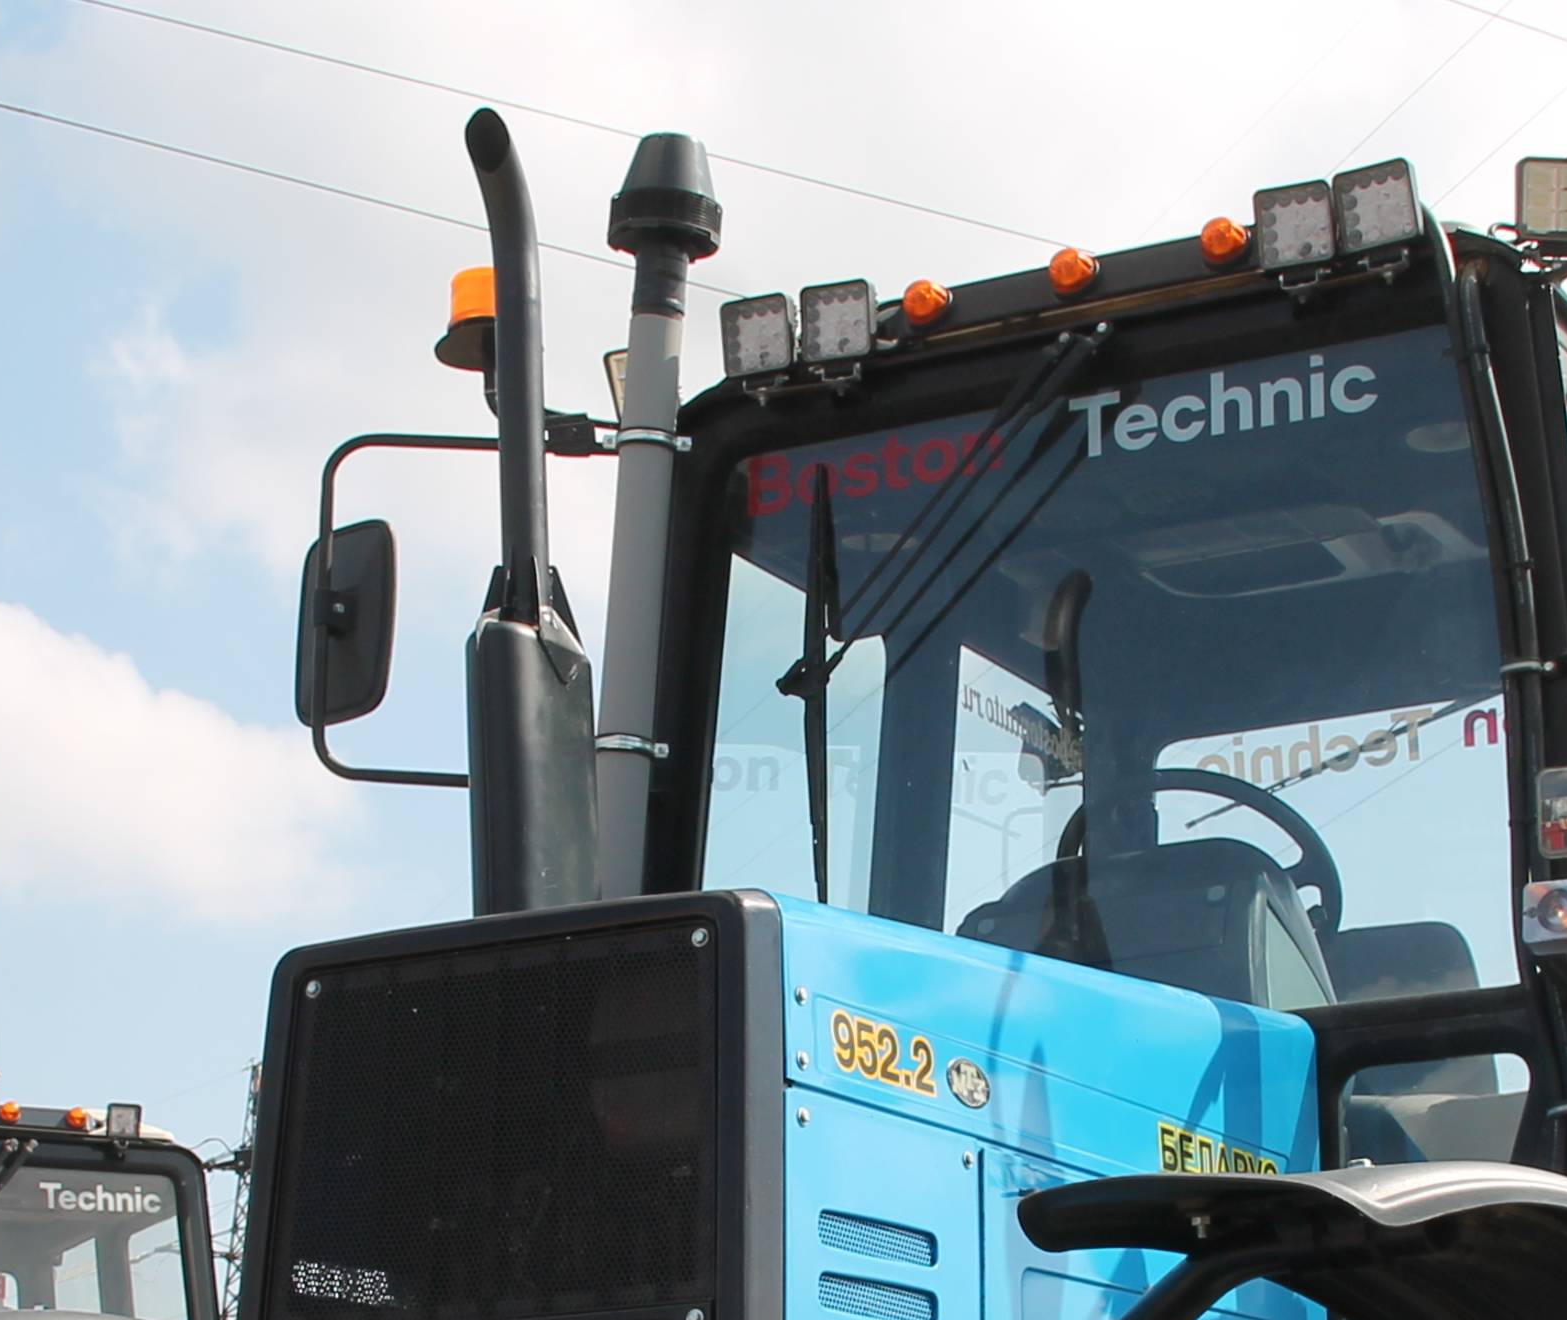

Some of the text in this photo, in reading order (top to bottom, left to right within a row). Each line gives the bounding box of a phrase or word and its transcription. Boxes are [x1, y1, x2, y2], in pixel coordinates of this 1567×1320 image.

[747, 354, 1379, 518] Boston Technic
[832, 1008, 937, 1097] 952.2
[1159, 1123, 1278, 1174] БЕЛАР
[39, 1182, 162, 1213] Technic
